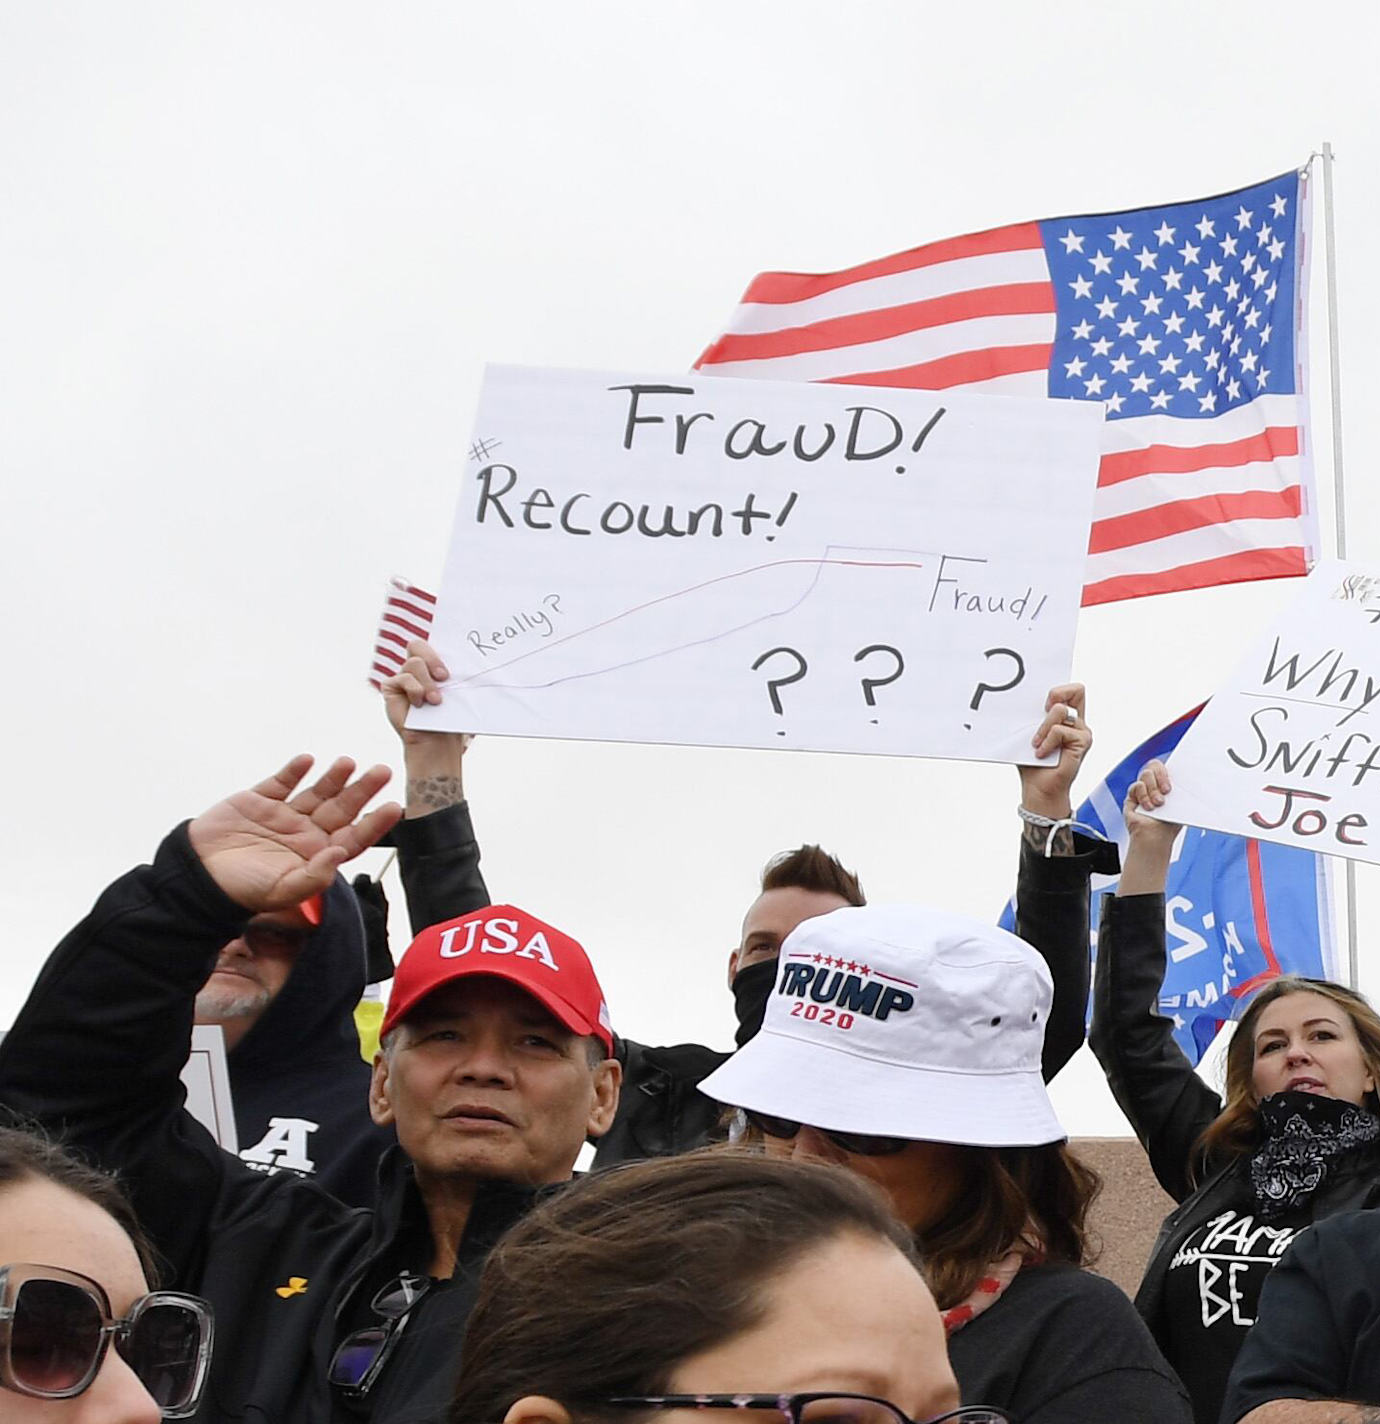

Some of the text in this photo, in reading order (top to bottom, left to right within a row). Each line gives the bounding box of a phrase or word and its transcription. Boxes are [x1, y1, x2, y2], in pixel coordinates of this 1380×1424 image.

[928, 553, 1048, 632] Fraud!
[467, 593, 562, 657] Really?
[1249, 785, 1368, 846] Joe
[439, 917, 559, 972] USA
[778, 961, 915, 1022] TRUMP
[790, 1001, 854, 1030] 2020
